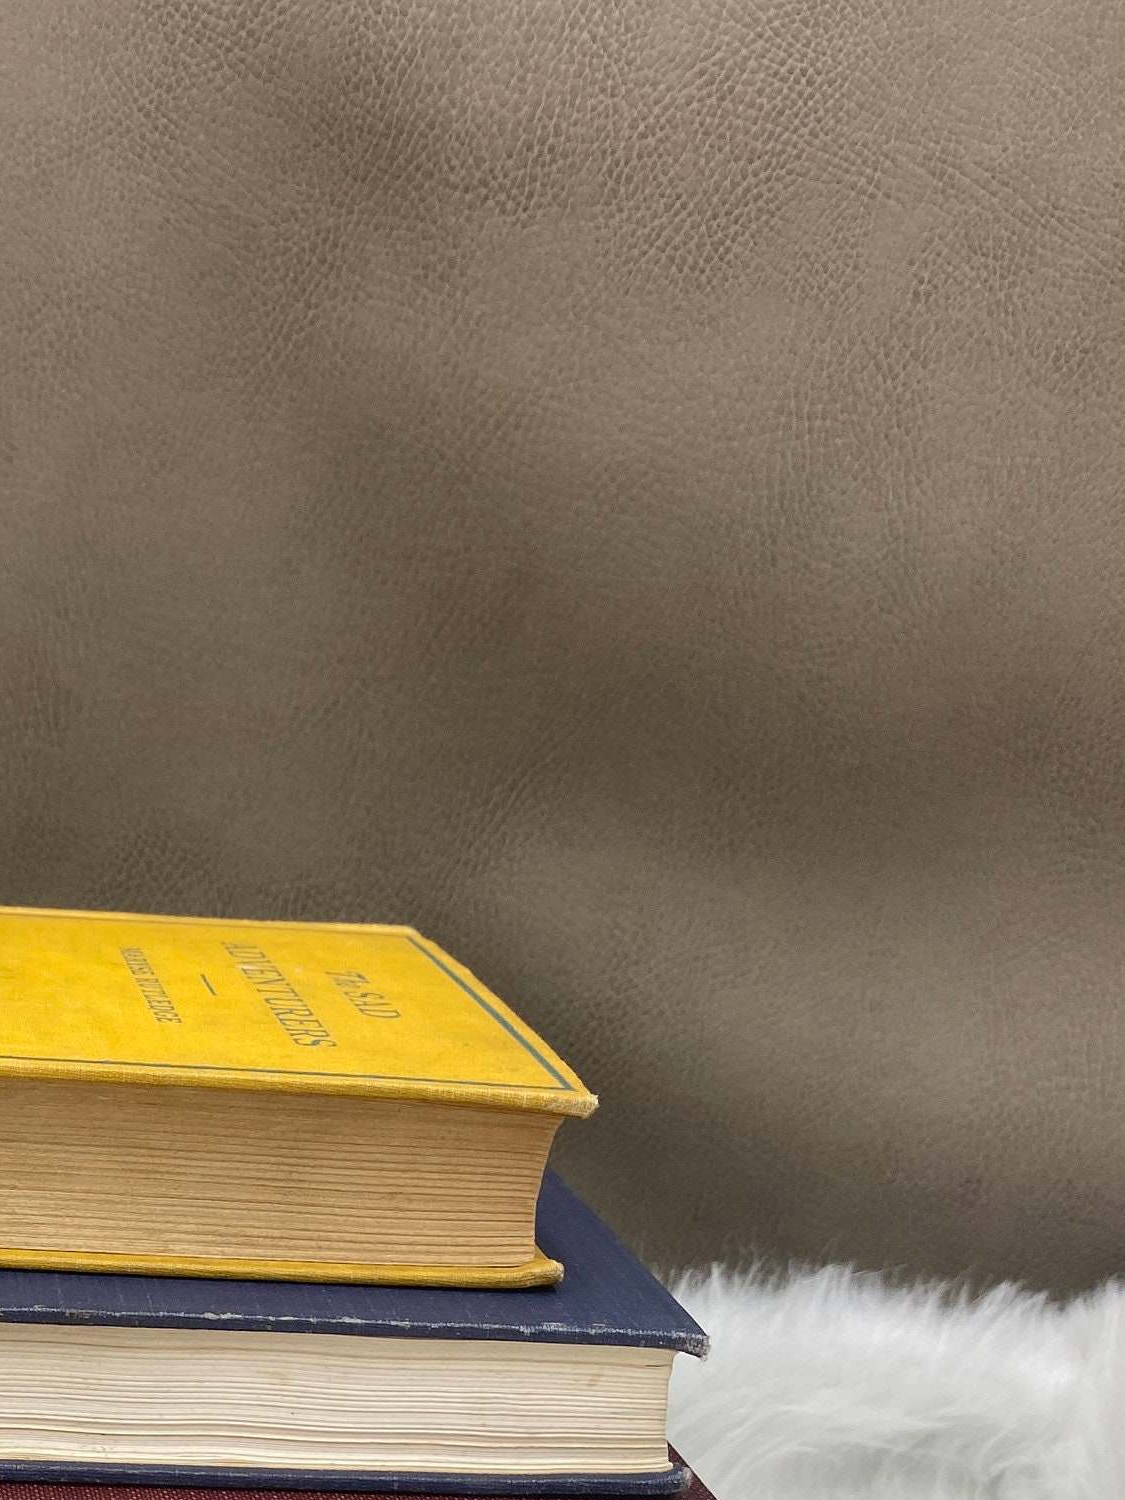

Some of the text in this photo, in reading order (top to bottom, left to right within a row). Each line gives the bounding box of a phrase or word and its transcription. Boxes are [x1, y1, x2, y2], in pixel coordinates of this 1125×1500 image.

[135, 977, 182, 1023] RUTLEDGE
[221, 941, 337, 1047] ADVENTURERS
[343, 991, 401, 1018] SAD
